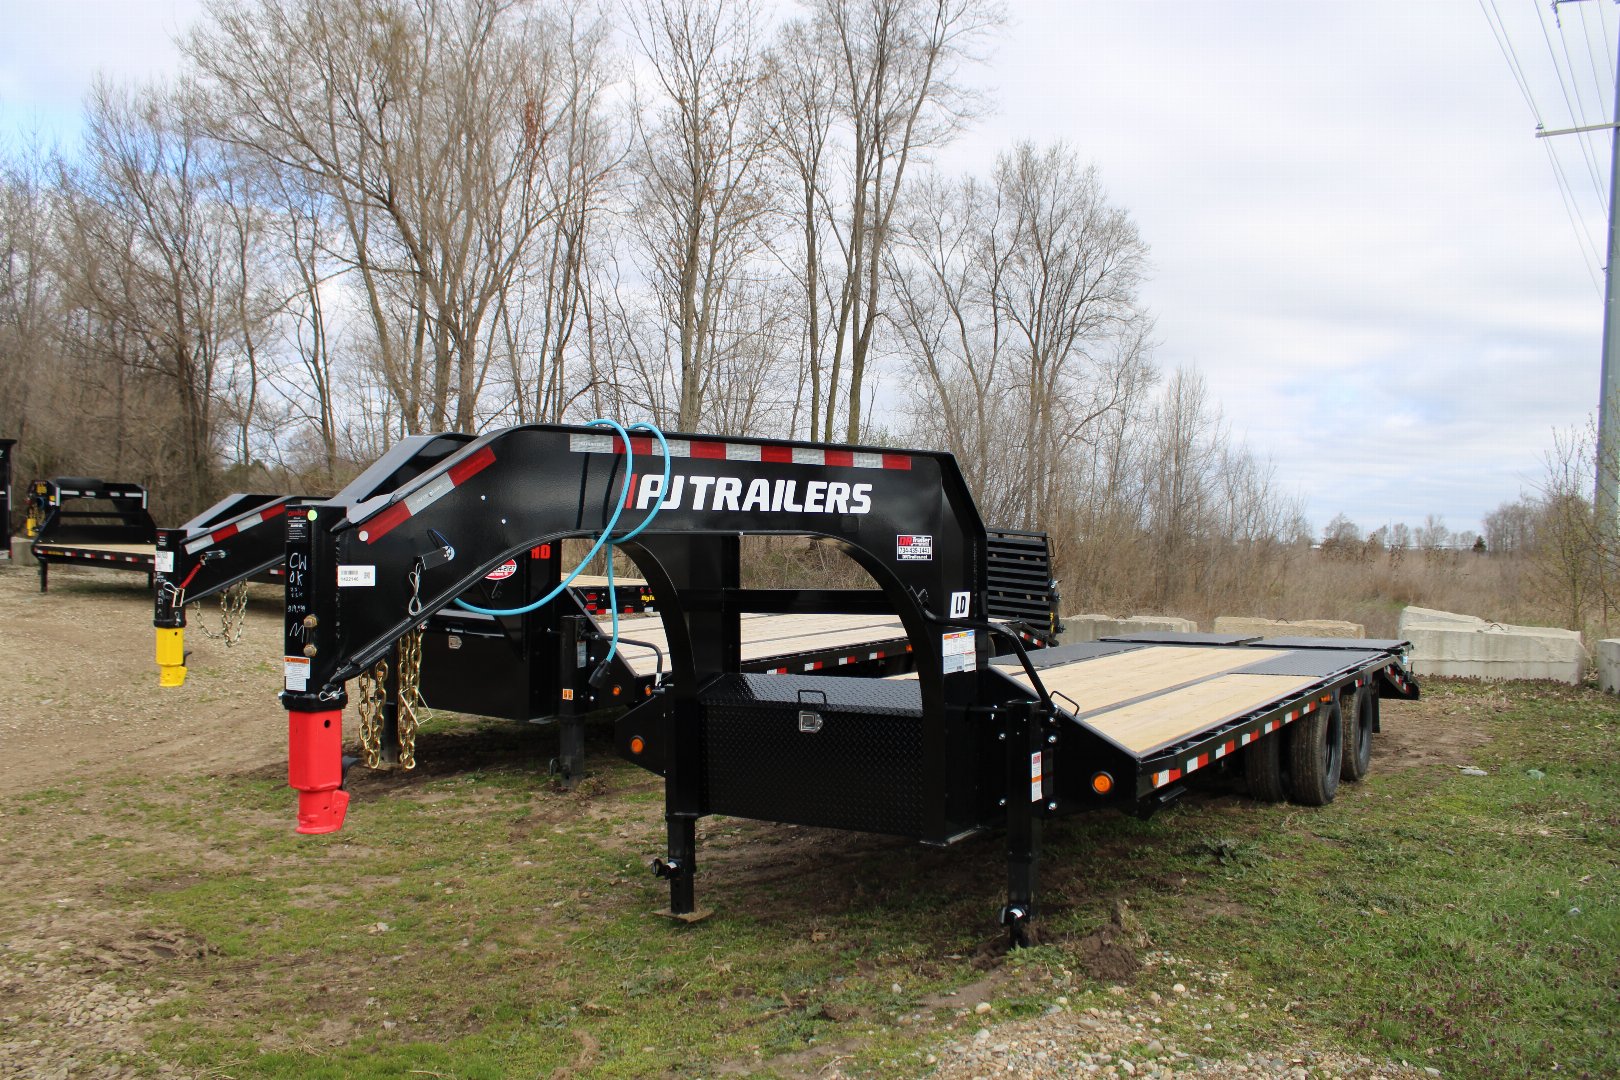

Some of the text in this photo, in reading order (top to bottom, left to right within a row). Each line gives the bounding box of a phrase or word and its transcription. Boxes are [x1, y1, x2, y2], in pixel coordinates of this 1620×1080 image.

[636, 474, 873, 514] PJ TRAILERS
[955, 595, 967, 614] LD
